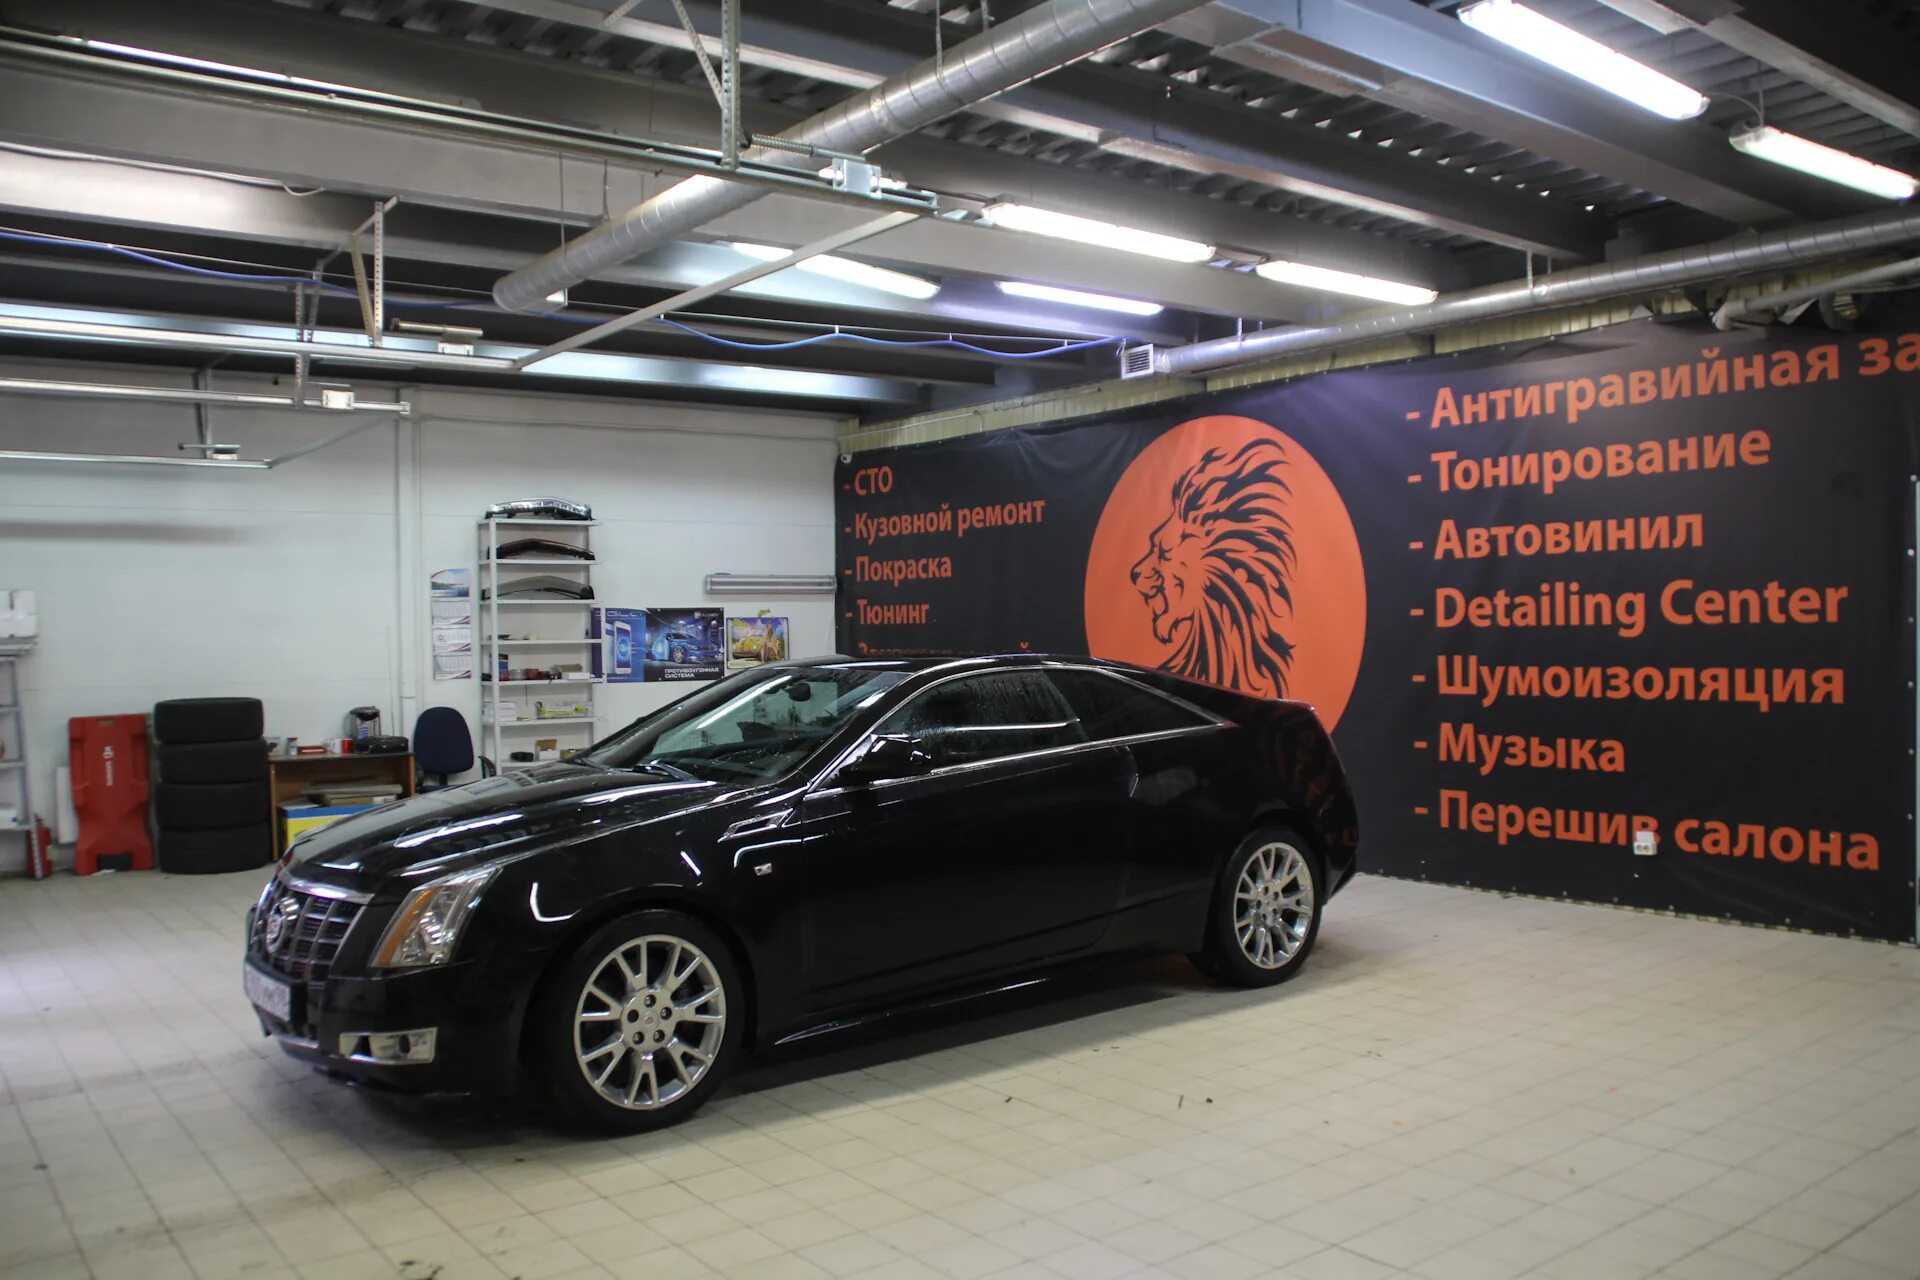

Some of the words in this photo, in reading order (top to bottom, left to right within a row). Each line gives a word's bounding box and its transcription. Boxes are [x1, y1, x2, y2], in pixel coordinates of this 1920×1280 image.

[1430, 343, 1841, 429] Антигравийная
[1858, 332, 1920, 377] за
[854, 465, 894, 497] СТО
[1430, 429, 1772, 495] Тонирование
[855, 502, 953, 545] Кузовной
[957, 499, 1046, 537] ремонт
[1433, 513, 1705, 560] Автовинил
[855, 555, 953, 587] Покраска
[857, 598, 930, 625] Тюнинг
[1434, 580, 1647, 638] Detailing
[1659, 578, 1851, 626] Center
[1436, 655, 1846, 713] Шумоизоляция
[1438, 721, 1627, 776] Музыка
[1439, 788, 1662, 847] Перешив
[1673, 818, 1882, 872] салона
